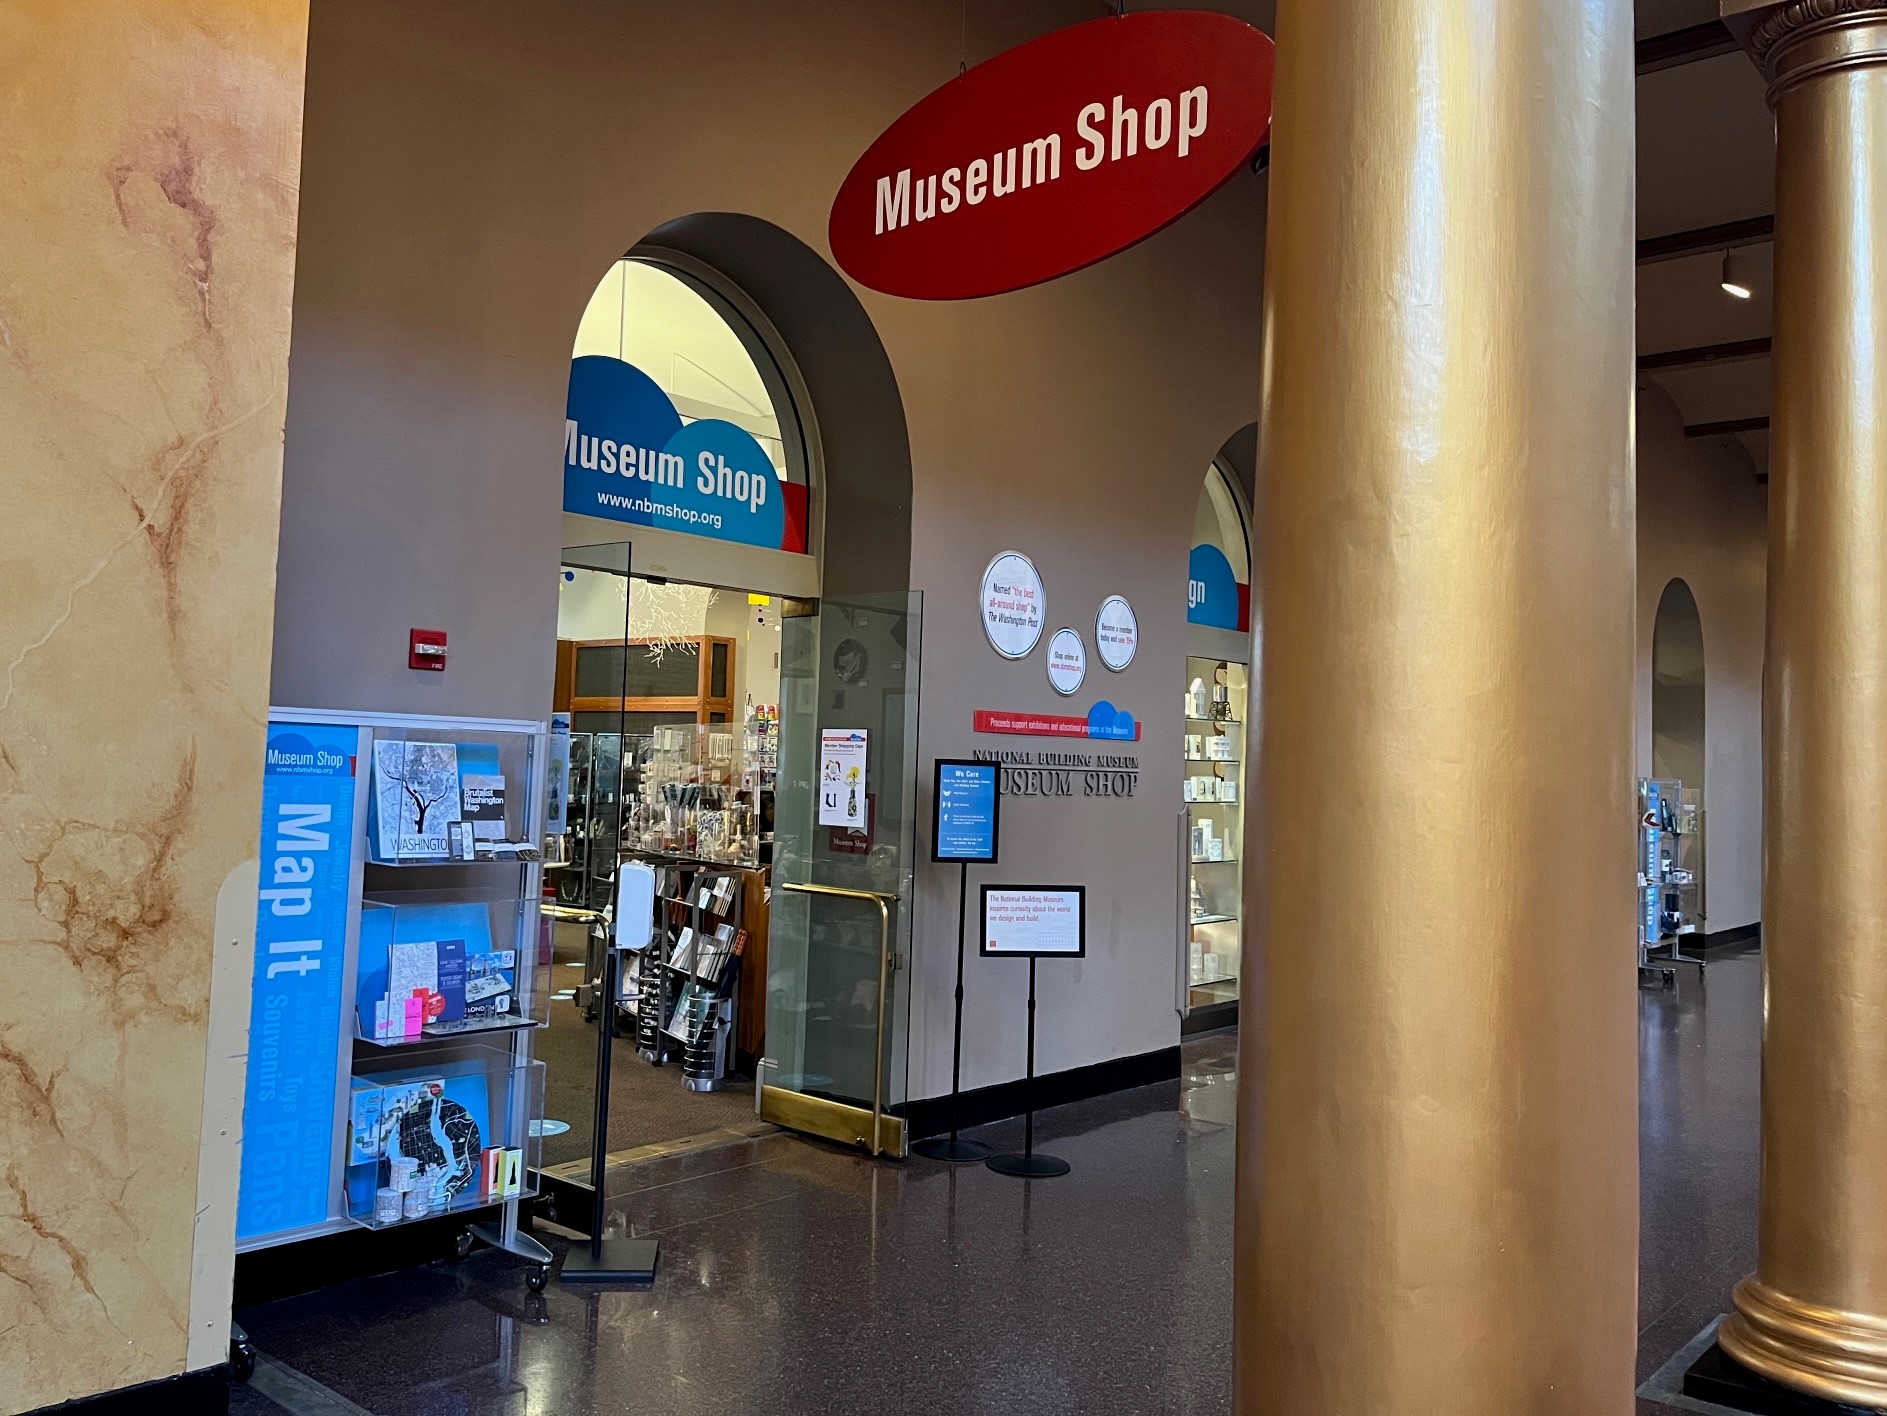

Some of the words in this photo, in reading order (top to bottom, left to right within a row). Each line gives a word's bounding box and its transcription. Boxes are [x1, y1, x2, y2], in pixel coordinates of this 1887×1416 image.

[875, 133, 1061, 235] Museum
[1075, 85, 1208, 172] Shop
[697, 450, 766, 513] Shop
[597, 491, 722, 529] www.nbmshop.org
[993, 582, 1011, 595] Named
[1023, 588, 1034, 598] best
[988, 611, 997, 622] The
[998, 613, 1027, 627] Washington
[1031, 604, 1037, 615] by
[268, 749, 314, 765] Museum
[317, 751, 343, 768] Shop
[974, 750, 1033, 765] NATIONAL
[1038, 752, 1091, 767] BUILDING
[1097, 755, 1139, 768] MUSEUM
[276, 766, 333, 775] www.nbmshop.org
[966, 770, 980, 778] Care
[1000, 769, 1073, 797] USEUM
[1084, 772, 1138, 797] SHOP
[464, 789, 493, 797] Brutalist
[464, 796, 504, 805] Washington
[464, 803, 480, 812] Map
[391, 837, 449, 851] WASHINGTO
[833, 837, 854, 847] Museum
[854, 838, 867, 848] Shop
[259, 803, 332, 916] Map
[330, 841, 348, 891] Jewelry
[1021, 895, 1042, 903] Building
[998, 914, 1014, 923] design
[266, 939, 323, 979] It
[327, 956, 342, 998] Kitchen
[317, 1005, 335, 1054] Blocks
[258, 995, 289, 1102] Souvenirs
[280, 1074, 304, 1113] Toys
[302, 1063, 333, 1184] Souvenirs
[249, 1120, 300, 1225] Pens
